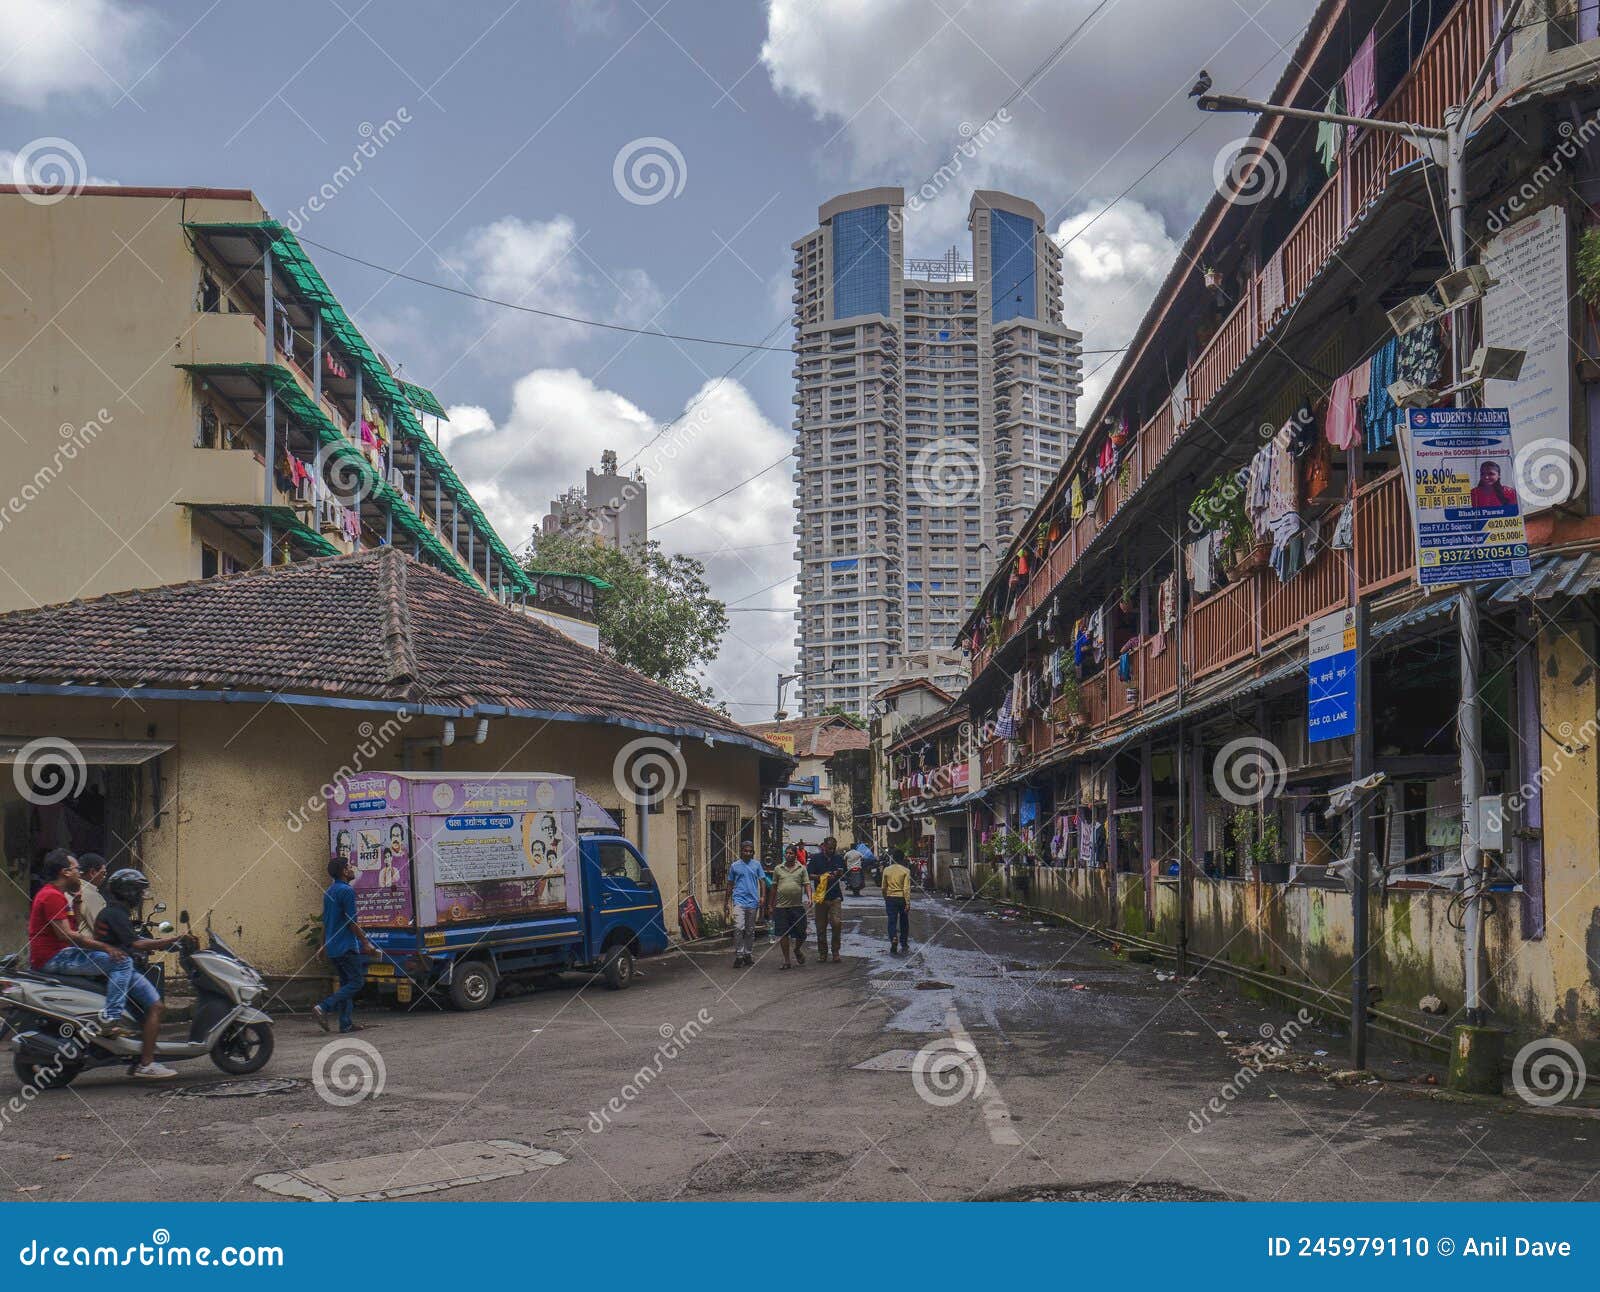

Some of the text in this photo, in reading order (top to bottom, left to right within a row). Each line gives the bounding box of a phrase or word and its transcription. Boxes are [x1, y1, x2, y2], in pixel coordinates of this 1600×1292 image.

[1431, 411, 1471, 423] STUDENT'S
[1473, 411, 1508, 423] ACADEMY
[1416, 450, 1443, 458] Experience
[1420, 524, 1431, 532] Join
[1421, 537, 1432, 545] Join
[1442, 536, 1462, 546] English
[1442, 546, 1512, 562] 9372197054
[1309, 717, 1320, 727] GAS
[1333, 711, 1348, 722] LANE
